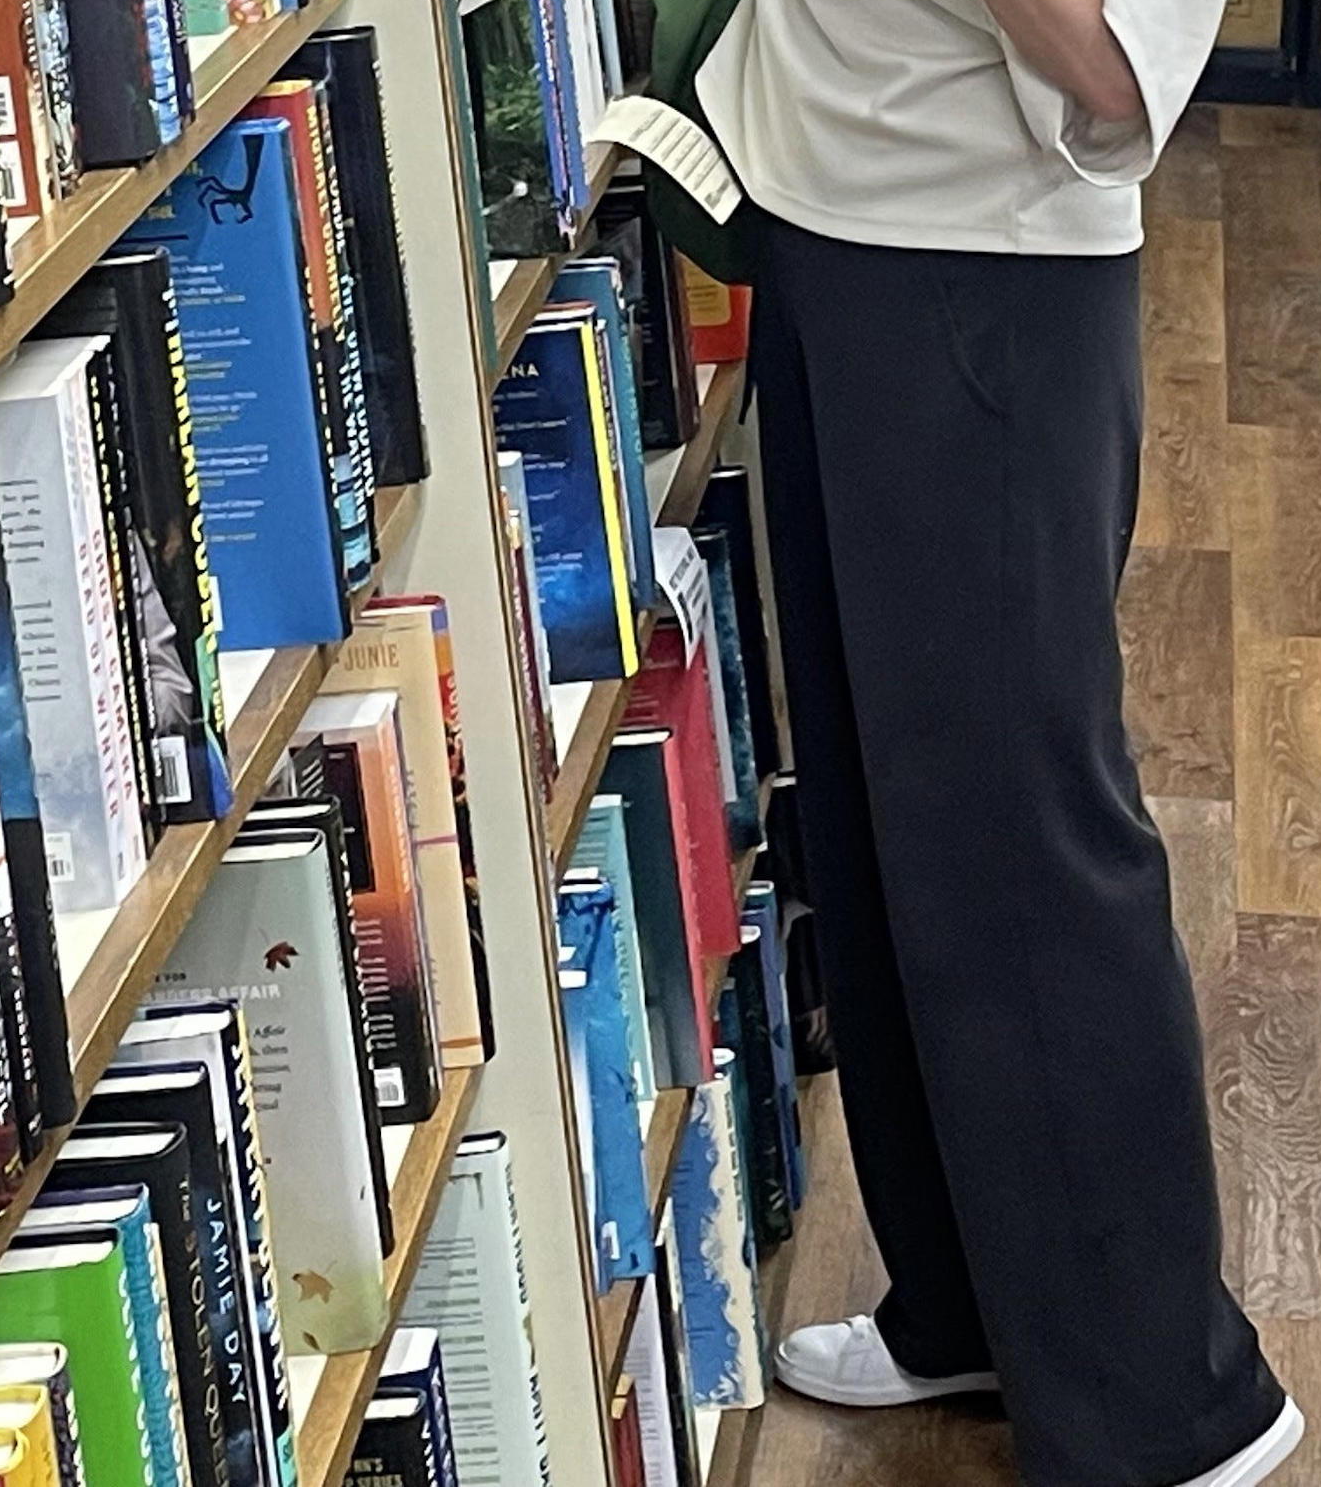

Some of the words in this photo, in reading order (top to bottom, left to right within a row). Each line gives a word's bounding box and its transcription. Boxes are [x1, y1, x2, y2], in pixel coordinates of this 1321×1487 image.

[344, 642, 400, 673] JUNIE
[205, 1197, 234, 1315] JAMIE
[225, 1335, 246, 1403] DAY
